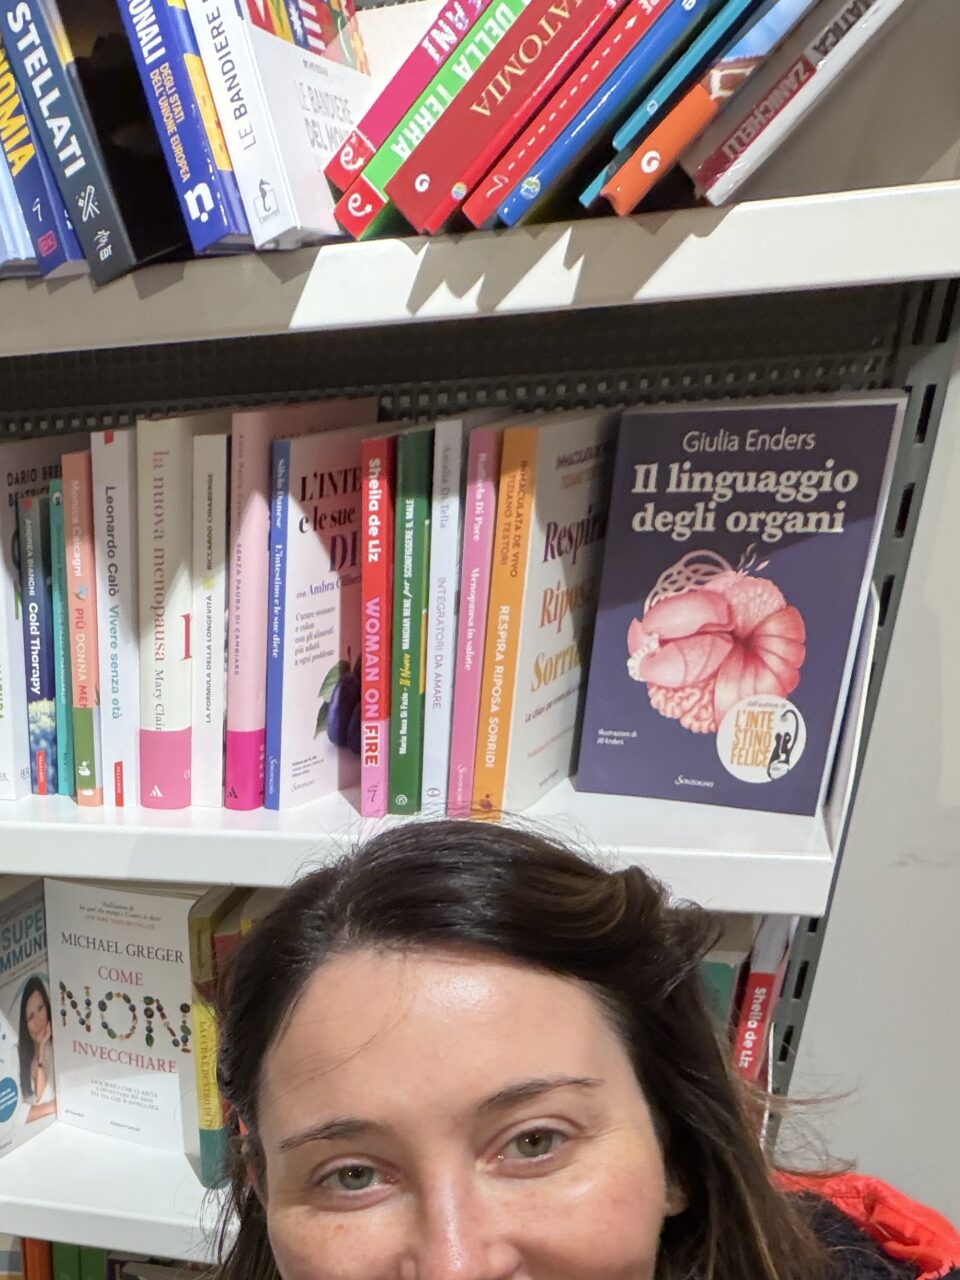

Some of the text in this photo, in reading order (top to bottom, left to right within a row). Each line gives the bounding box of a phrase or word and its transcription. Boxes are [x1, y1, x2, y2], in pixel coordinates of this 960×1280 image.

[6, 4, 86, 179] STELLATI
[159, 63, 185, 126] DEGLI STATI
[204, 14, 258, 151] LE BANDIERE
[390, 2, 516, 160] DELLA TERRA
[150, 69, 190, 183] DELL'UNIONE EUROPEA
[152, 450, 169, 469] la
[682, 425, 817, 453] Giulia Enders
[631, 458, 860, 504] Il linguaggio
[105, 485, 117, 560] Leonardo
[152, 477, 164, 540] nuova
[299, 504, 356, 534] e le sue
[367, 458, 381, 562] Sheila de Liz
[499, 473, 515, 566] TIZIANO TESTORI
[631, 501, 847, 542] degli organi
[512, 534, 522, 548] DE
[27, 558, 36, 596] BIANCHI
[107, 562, 118, 597] Calò
[509, 550, 520, 578] VIVO
[150, 545, 166, 662] menopausa
[308, 580, 335, 596] Ambra
[28, 602, 39, 635] Cold
[109, 604, 118, 649] Vivere
[432, 577, 446, 709] INTEGRATORI DA AMARE
[29, 637, 42, 694] Therapy
[153, 668, 164, 700] Mary
[363, 596, 382, 767] WOMAN ON FIRE
[485, 604, 510, 768] RESPIRA RIPOSA SORRIDI
[111, 697, 120, 719] età
[735, 709, 775, 730] L'INTE
[730, 741, 771, 768] FELICE
[733, 728, 771, 752] STINO
[61, 932, 185, 964] MICHAEL GREGER
[98, 965, 144, 987] COME
[59, 981, 192, 1053] NON
[746, 985, 768, 1029] Sheila
[72, 1040, 177, 1074] INVECCHIARE
[743, 1029, 758, 1048] de
